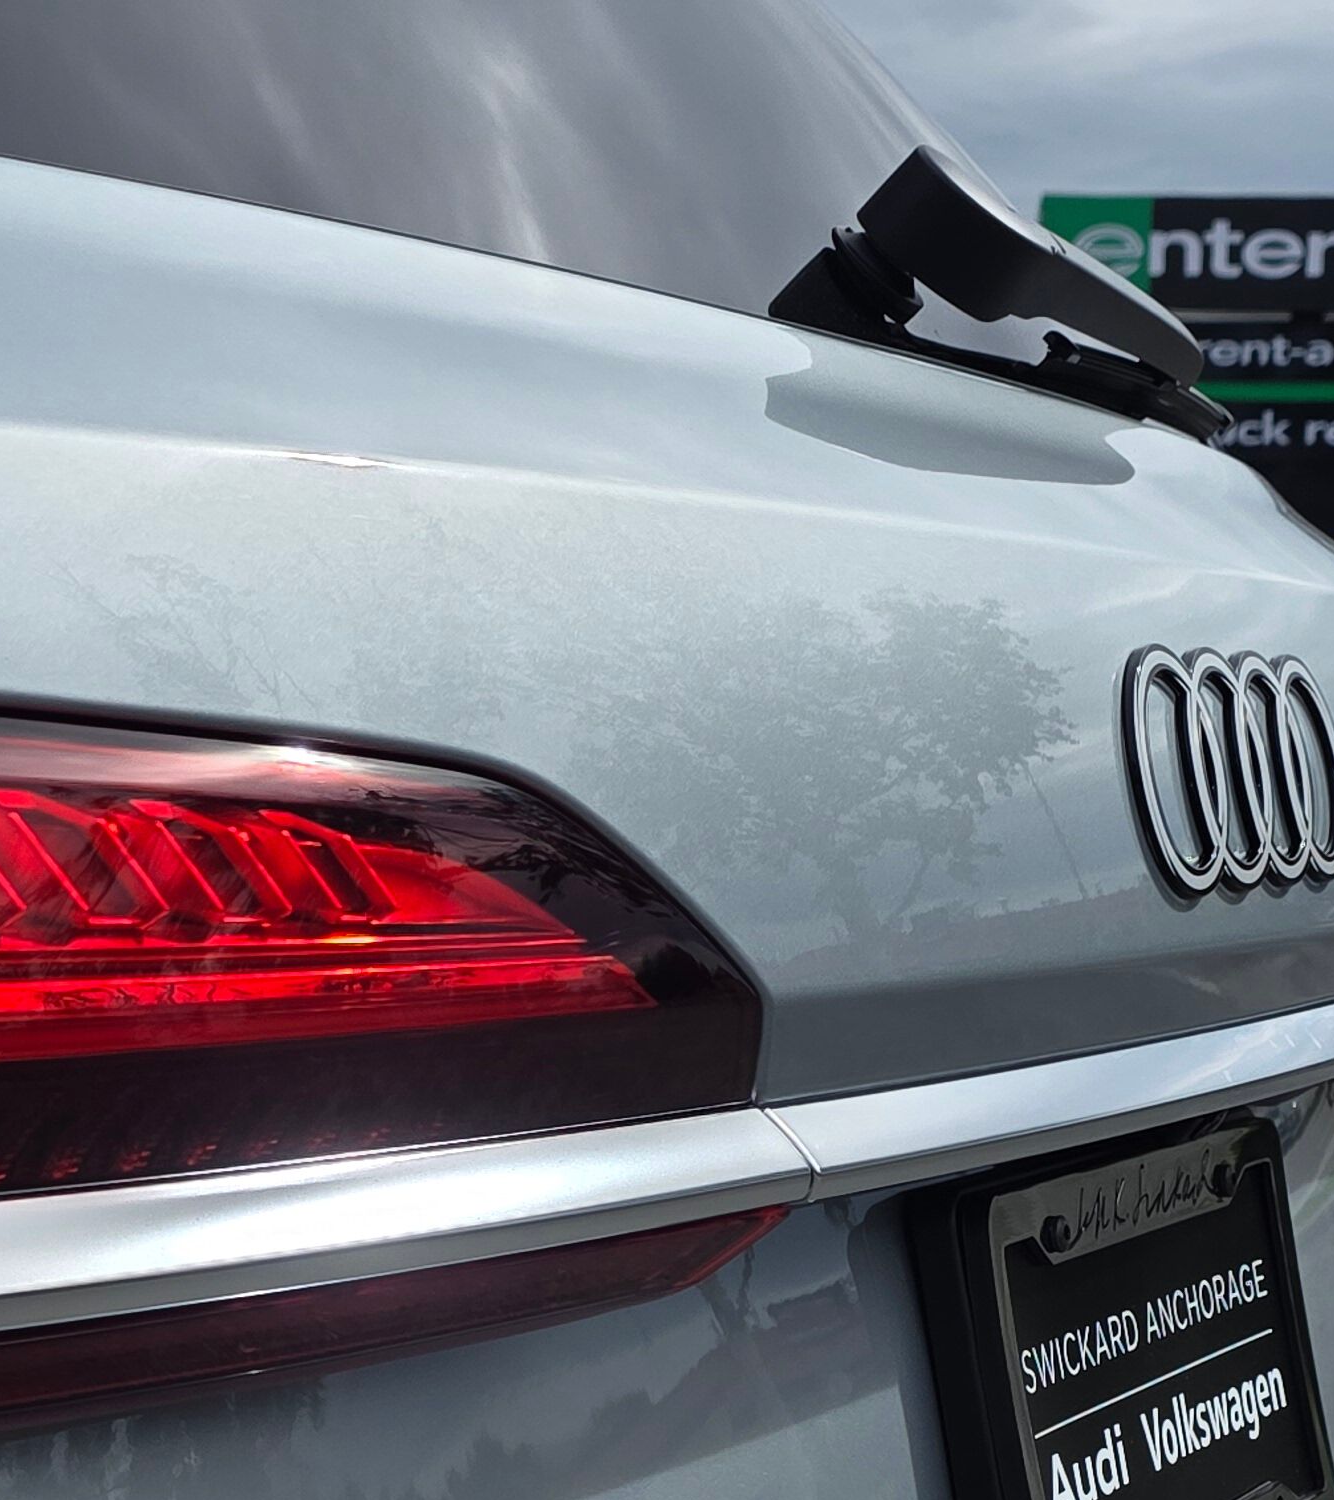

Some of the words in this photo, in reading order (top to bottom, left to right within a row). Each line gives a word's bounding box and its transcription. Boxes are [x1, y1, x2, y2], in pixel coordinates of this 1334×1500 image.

[1214, 408, 1292, 447] uck
[1021, 1309, 1139, 1394] SWICKARD
[1146, 1259, 1268, 1344] ANCHORAGE
[1140, 1367, 1288, 1472] Volkswagen
